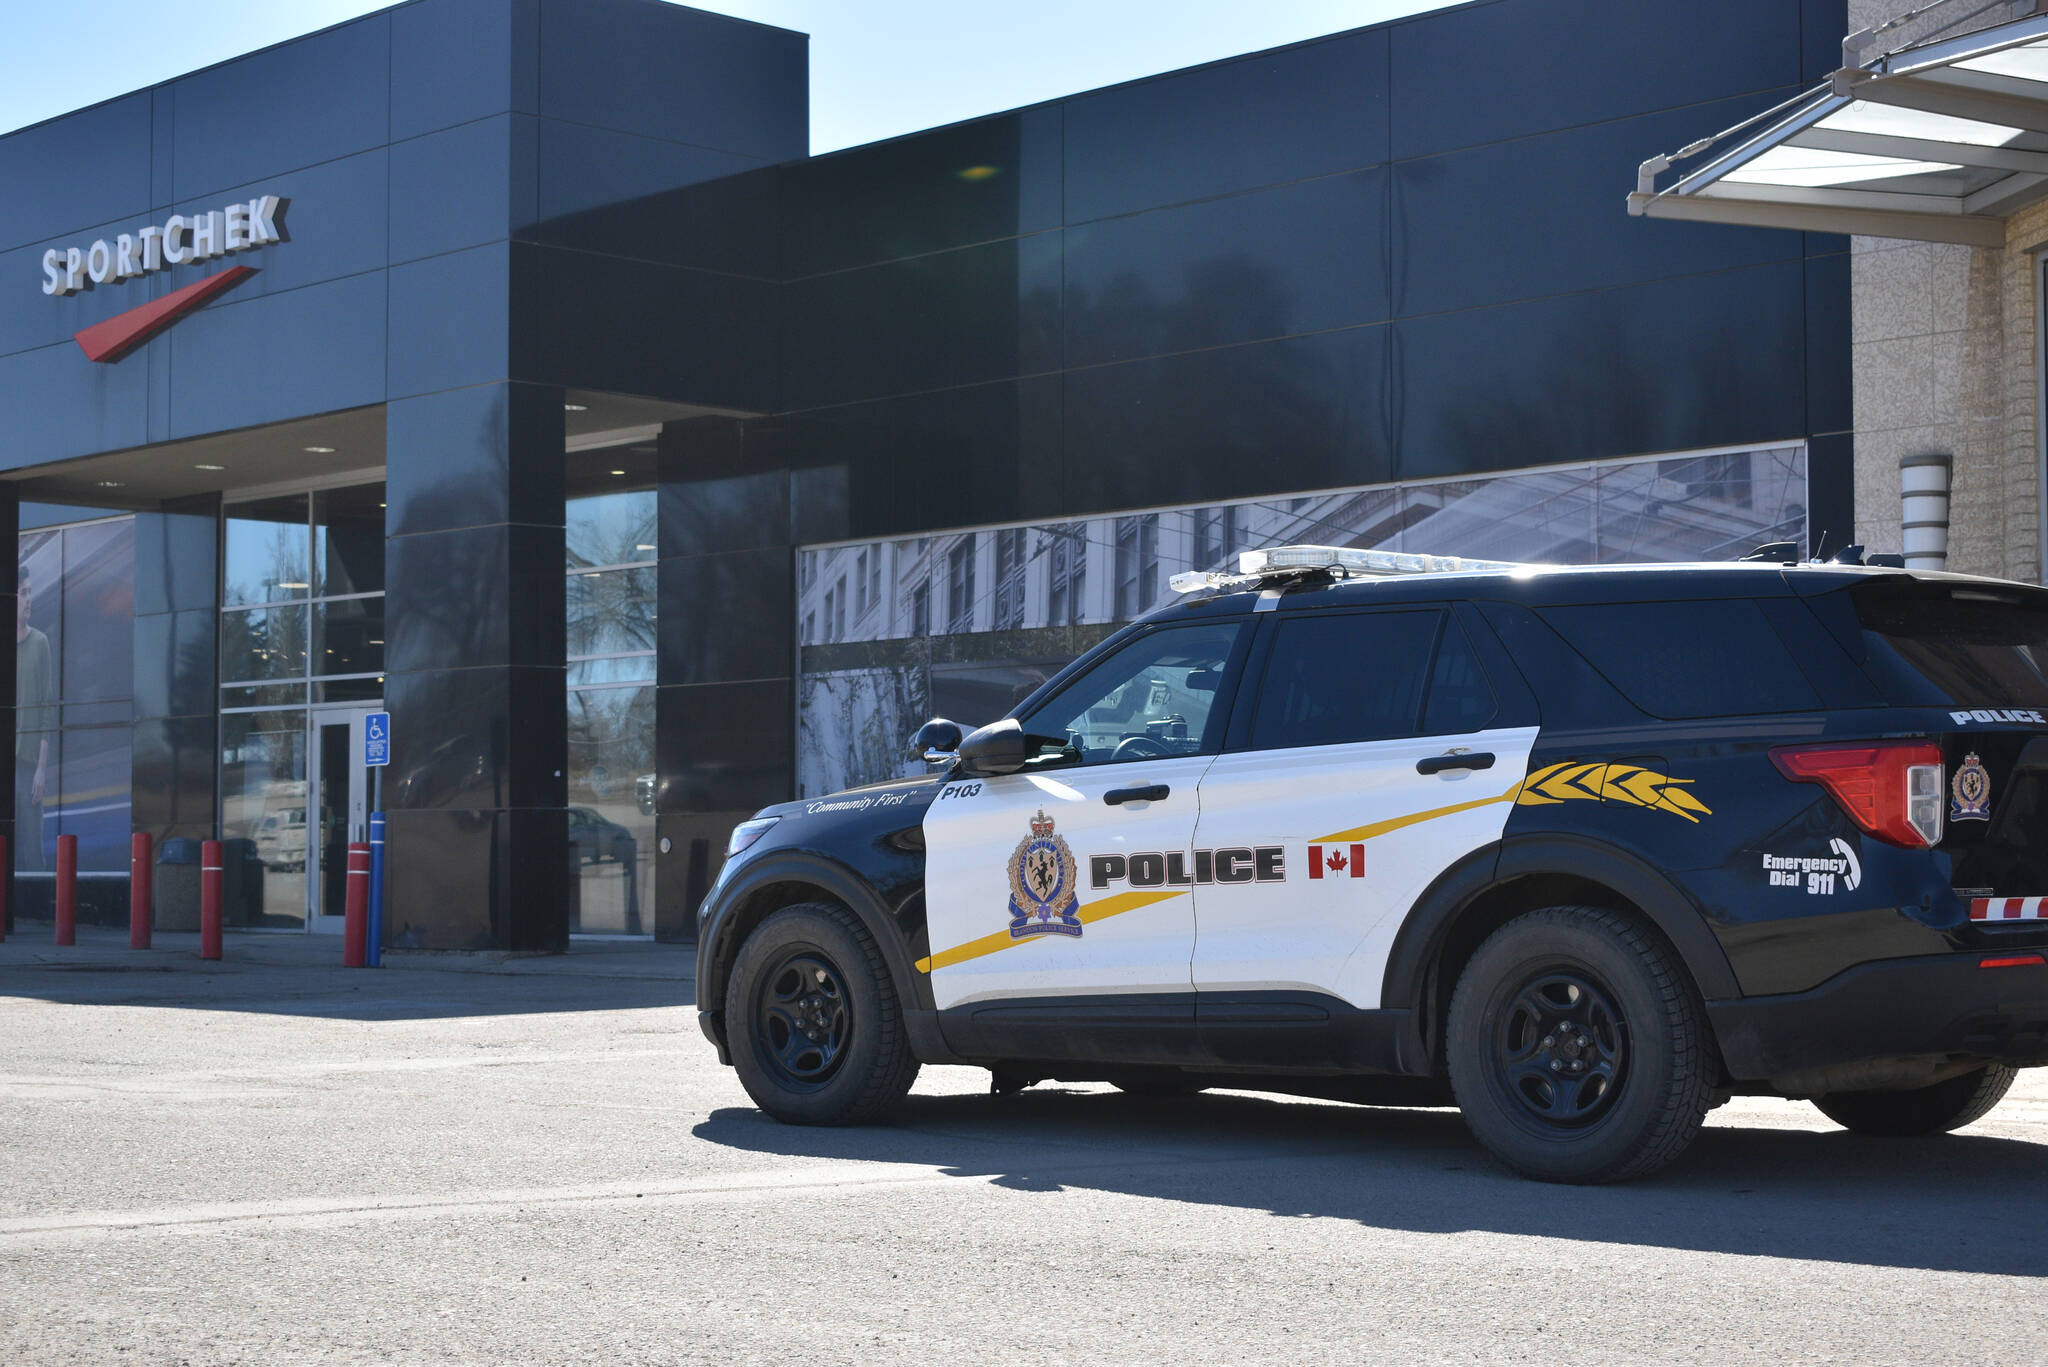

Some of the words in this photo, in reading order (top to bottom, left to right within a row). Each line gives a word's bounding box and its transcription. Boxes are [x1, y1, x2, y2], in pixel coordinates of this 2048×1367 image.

[42, 195, 280, 296] SPORTCHEK
[1949, 709, 2046, 726] POLICE
[941, 783, 982, 800] P103
[1089, 845, 1286, 890] POLICE
[1762, 853, 1847, 874] Emergency
[1769, 871, 1800, 887] Dial
[1807, 873, 1834, 895] 911
